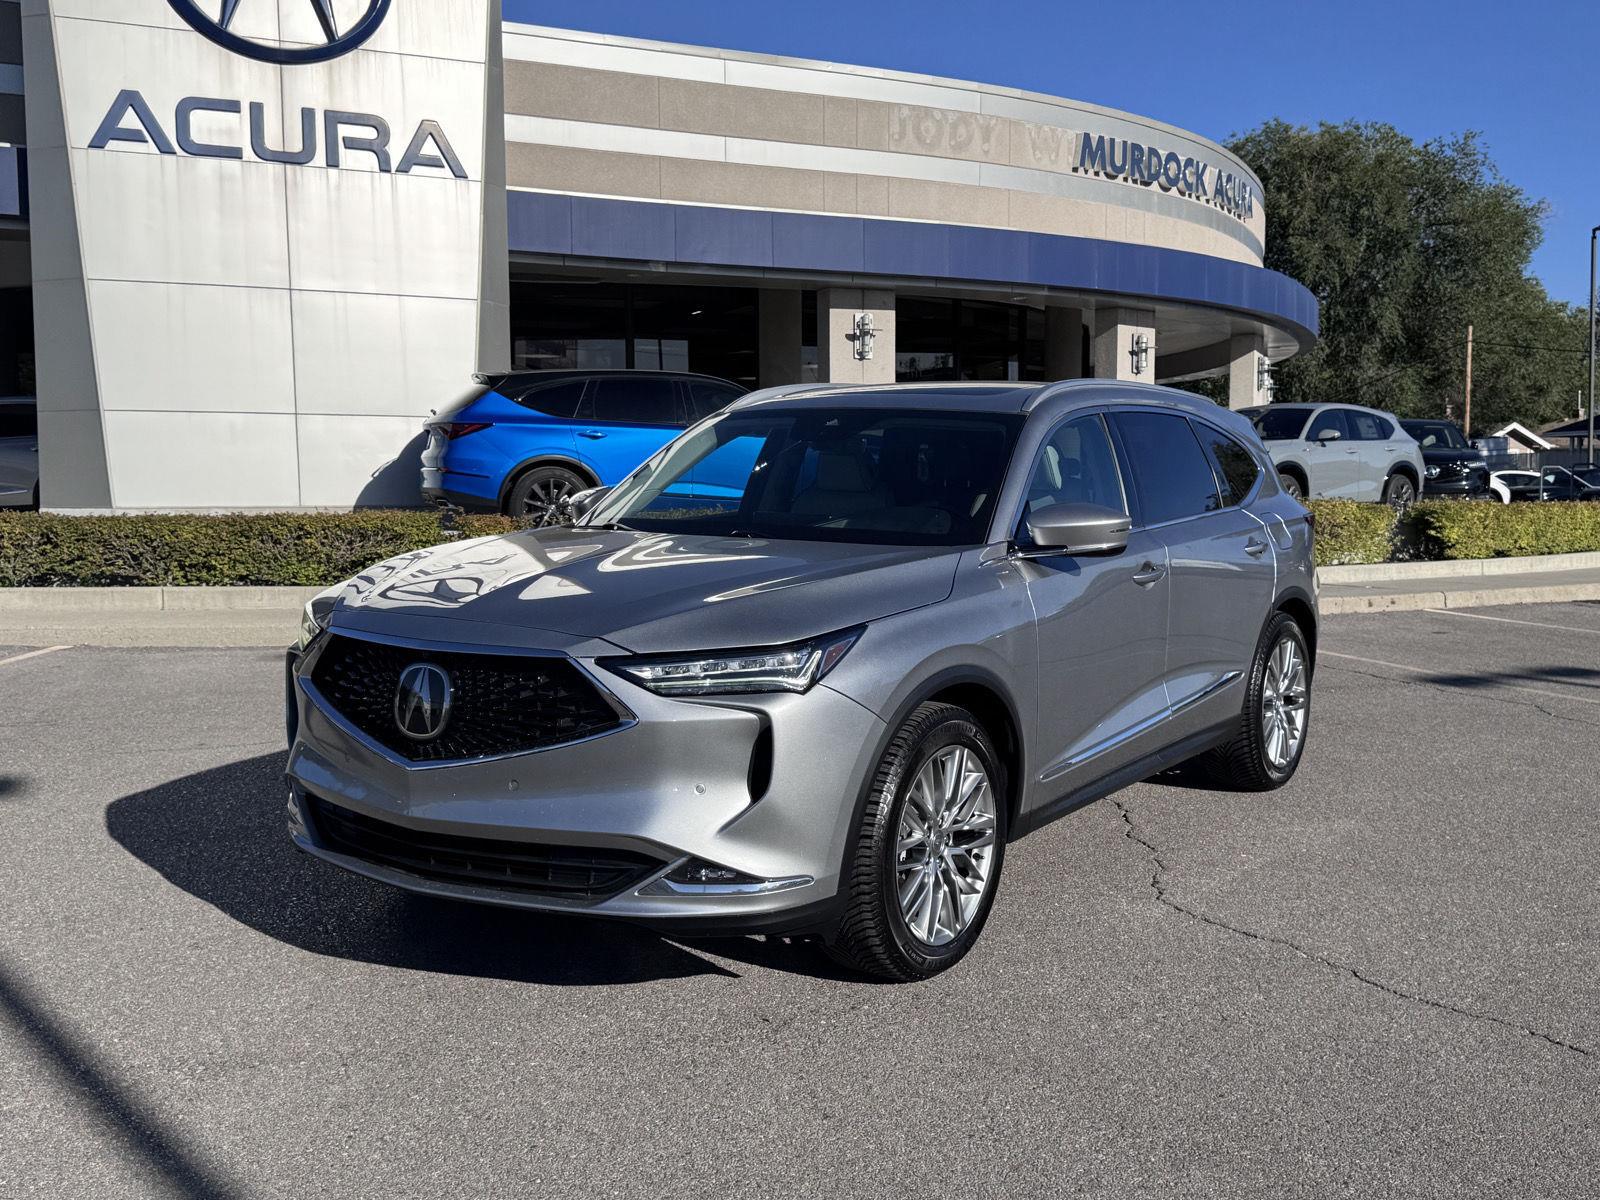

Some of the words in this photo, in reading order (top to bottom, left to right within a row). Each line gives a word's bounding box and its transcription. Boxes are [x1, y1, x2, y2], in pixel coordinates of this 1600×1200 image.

[87, 88, 469, 180] ACURA
[1076, 131, 1208, 198] MURDOCK
[1212, 167, 1254, 219] ACURA
